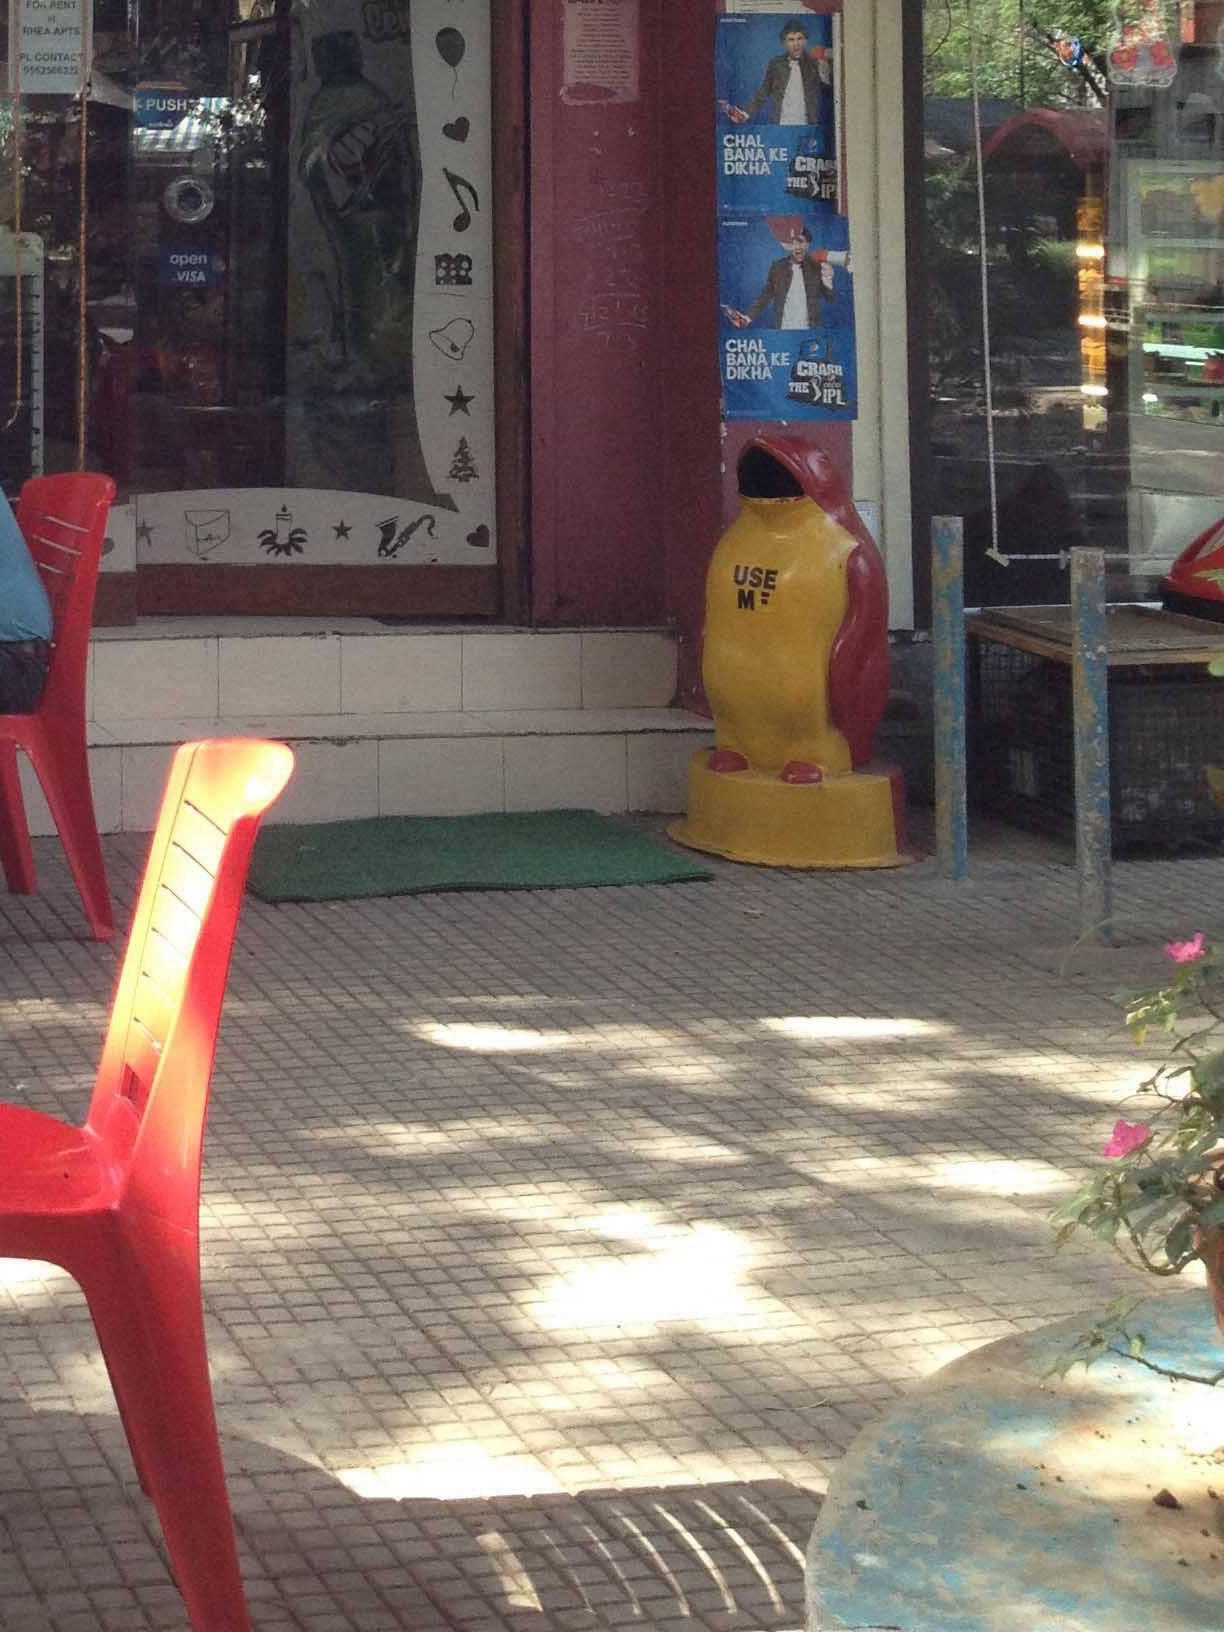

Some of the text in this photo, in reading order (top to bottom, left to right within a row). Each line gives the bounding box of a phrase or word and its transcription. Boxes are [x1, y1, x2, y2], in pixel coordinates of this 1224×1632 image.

[50, 0, 76, 9] RENT
[34, 52, 84, 62] CONTACT
[145, 98, 187, 111] PUSH
[723, 134, 764, 147] CHAL
[724, 148, 788, 161] BANA KE
[724, 161, 771, 175] DIKHA
[787, 177, 808, 188] THE
[170, 253, 207, 266] open
[177, 271, 206, 282] VISA
[726, 339, 767, 352] CHAL
[726, 352, 790, 366] BANA KE
[727, 366, 773, 380] DIKHA
[797, 360, 843, 377] CRASH
[788, 382, 809, 394] THE
[822, 389, 846, 405] IPL
[734, 565, 778, 590] USE
